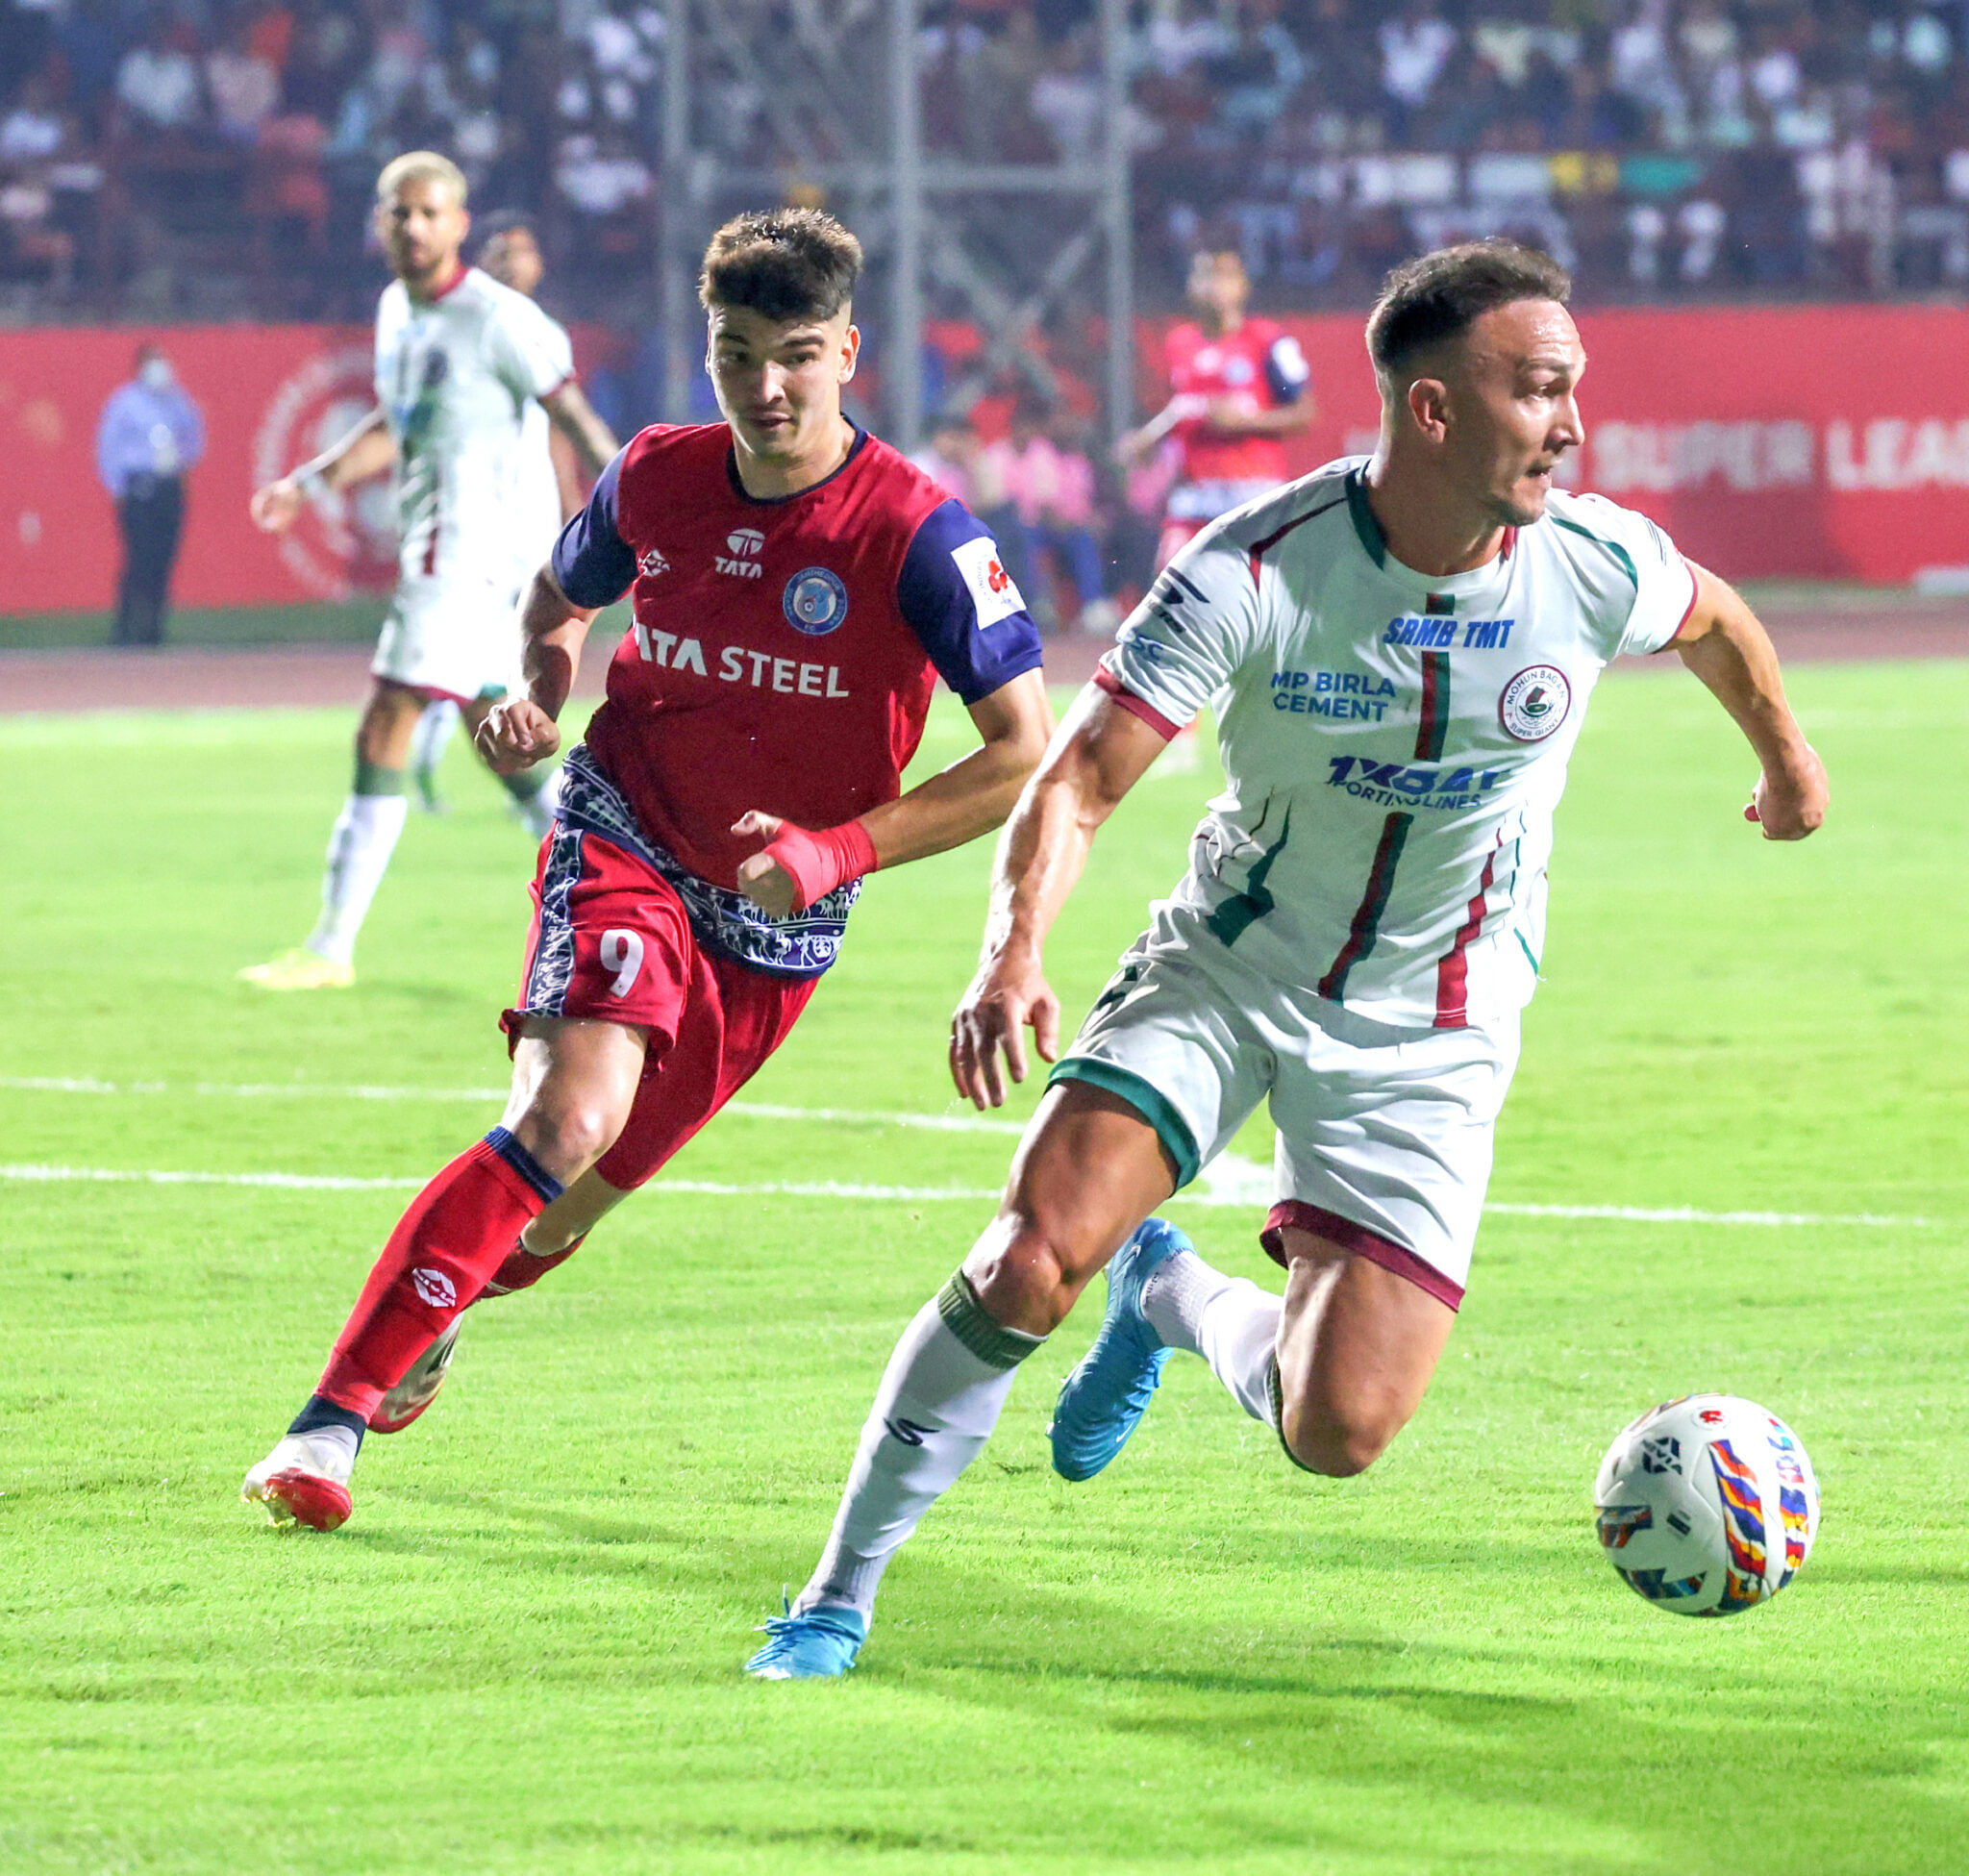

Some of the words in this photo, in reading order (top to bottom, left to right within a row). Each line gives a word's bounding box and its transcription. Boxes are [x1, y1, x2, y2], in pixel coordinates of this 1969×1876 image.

[714, 556, 762, 579] TATA
[1462, 619, 1514, 649] TMT
[632, 613, 708, 677] ATA
[718, 645, 849, 698] STEEL
[1270, 670, 1309, 689] MP
[1315, 671, 1396, 698] BIRLA
[1507, 670, 1538, 705] MOHUN
[1273, 692, 1388, 722] CEMENT
[600, 929, 645, 999] 9
